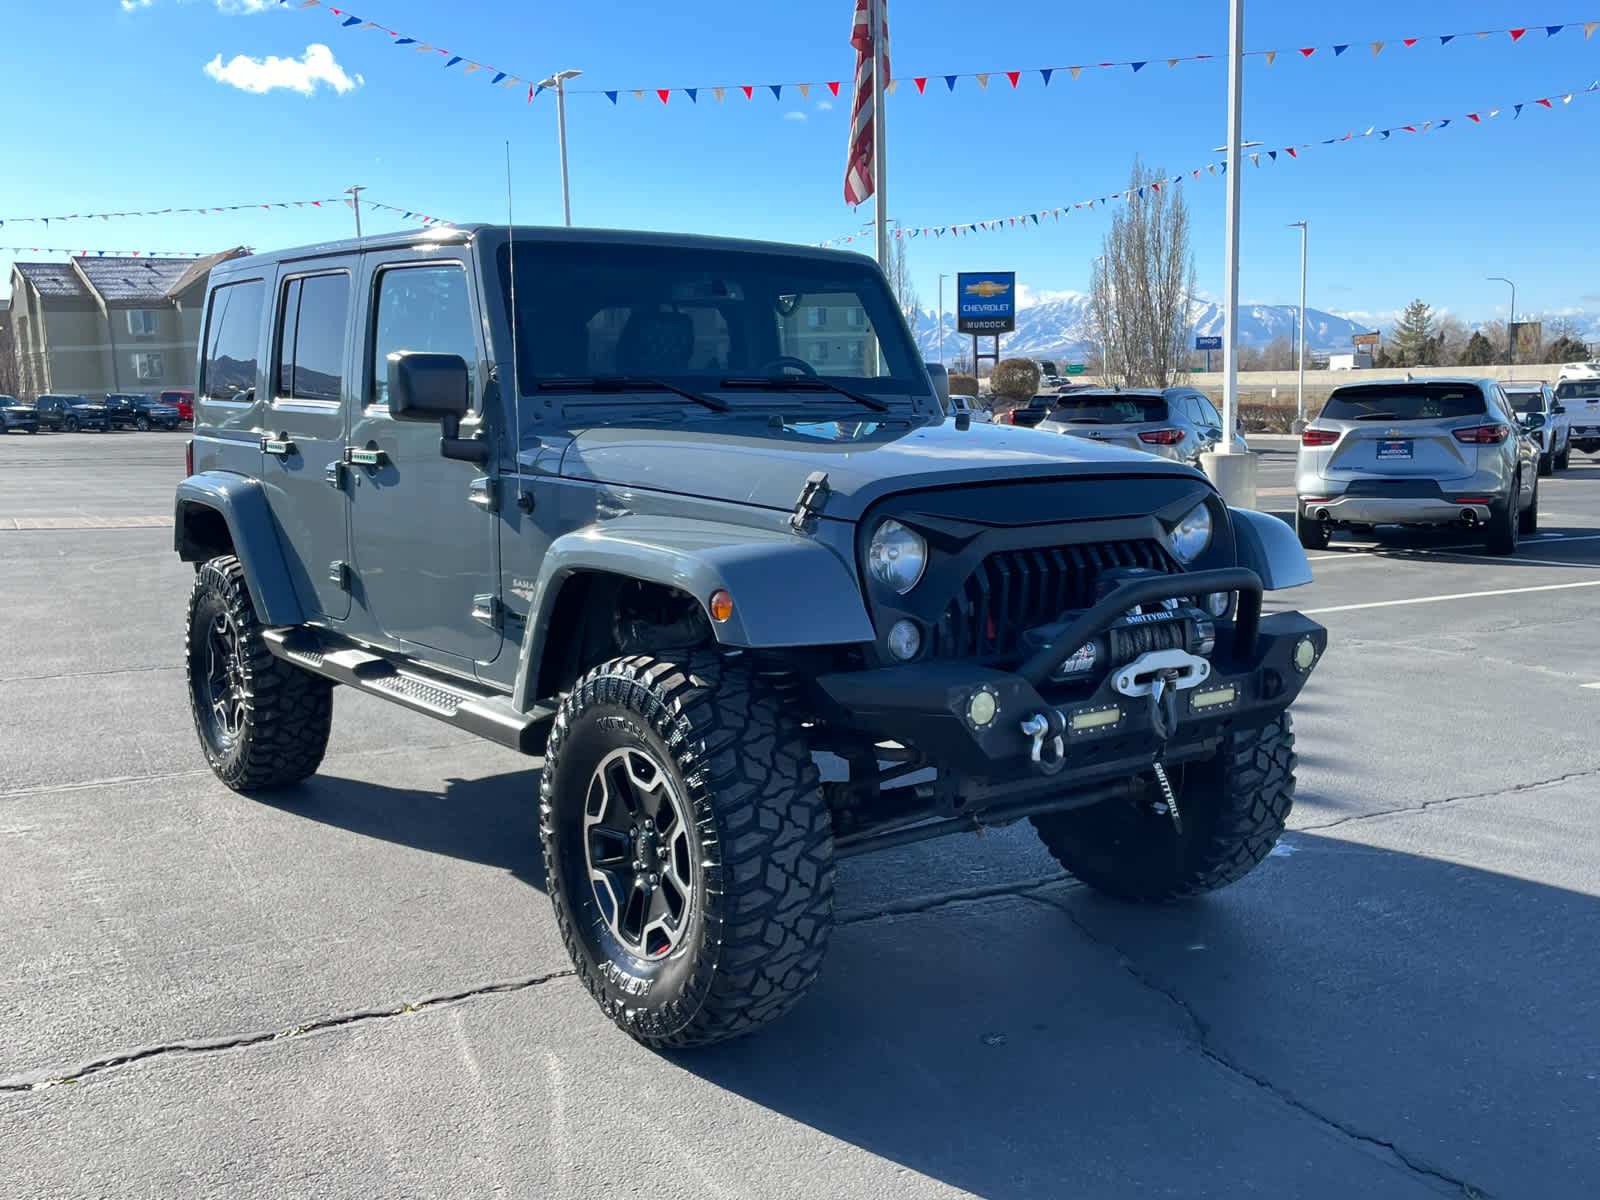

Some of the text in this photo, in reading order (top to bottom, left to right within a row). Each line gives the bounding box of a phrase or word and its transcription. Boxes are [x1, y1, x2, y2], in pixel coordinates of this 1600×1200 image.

[962, 303, 1010, 312] CHEVROLET
[967, 320, 1007, 329] MURDOCK
[1125, 610, 1174, 625] SMITTYBILT
[1152, 761, 1180, 818] SMITTYBILT
